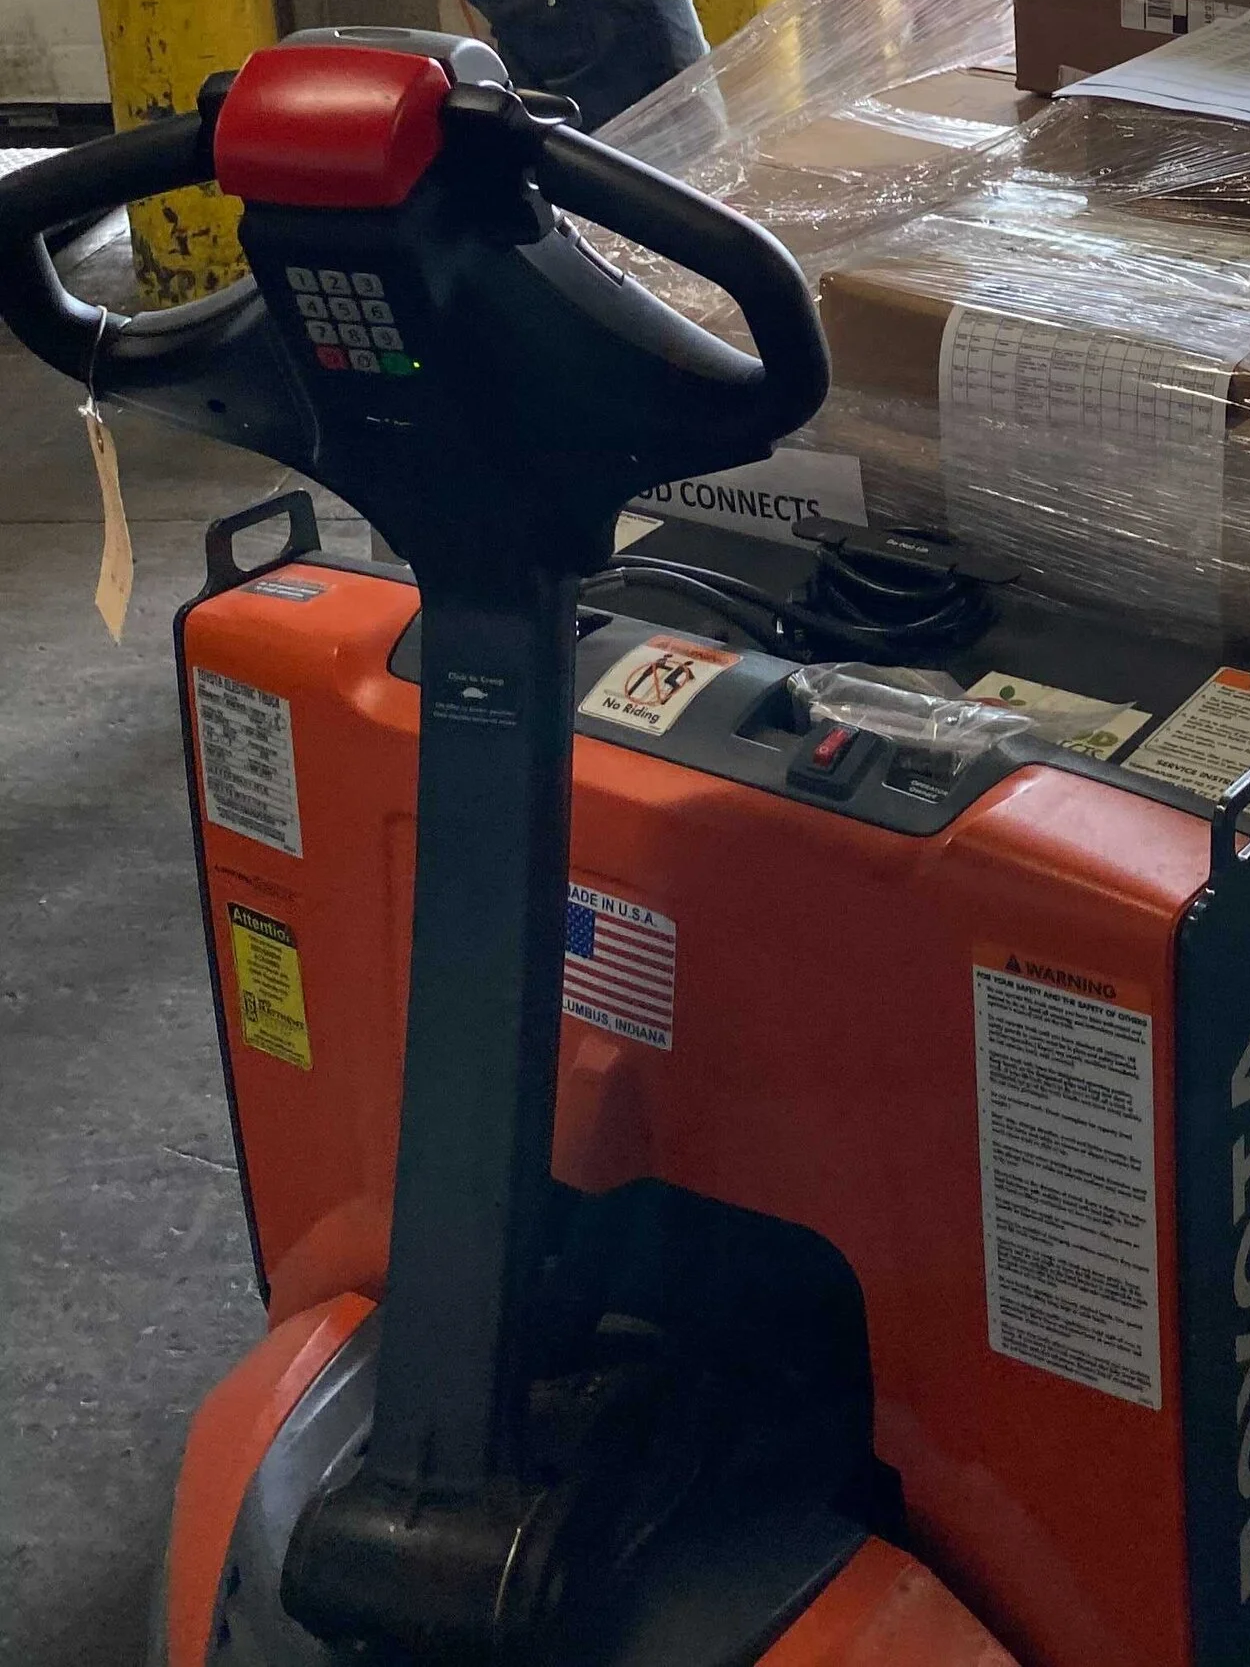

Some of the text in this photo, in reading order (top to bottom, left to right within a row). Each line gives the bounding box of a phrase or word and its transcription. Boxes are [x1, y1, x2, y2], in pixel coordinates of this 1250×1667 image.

[680, 482, 820, 522] CONNECTS
[602, 697, 660, 724] No Riding
[1156, 759, 1233, 786] SERVICE INSTR
[569, 885, 658, 927] ADE IN U.S.A.
[1026, 960, 1117, 1000] WARNING
[563, 998, 667, 1045] LUMBUS, INDIANA
